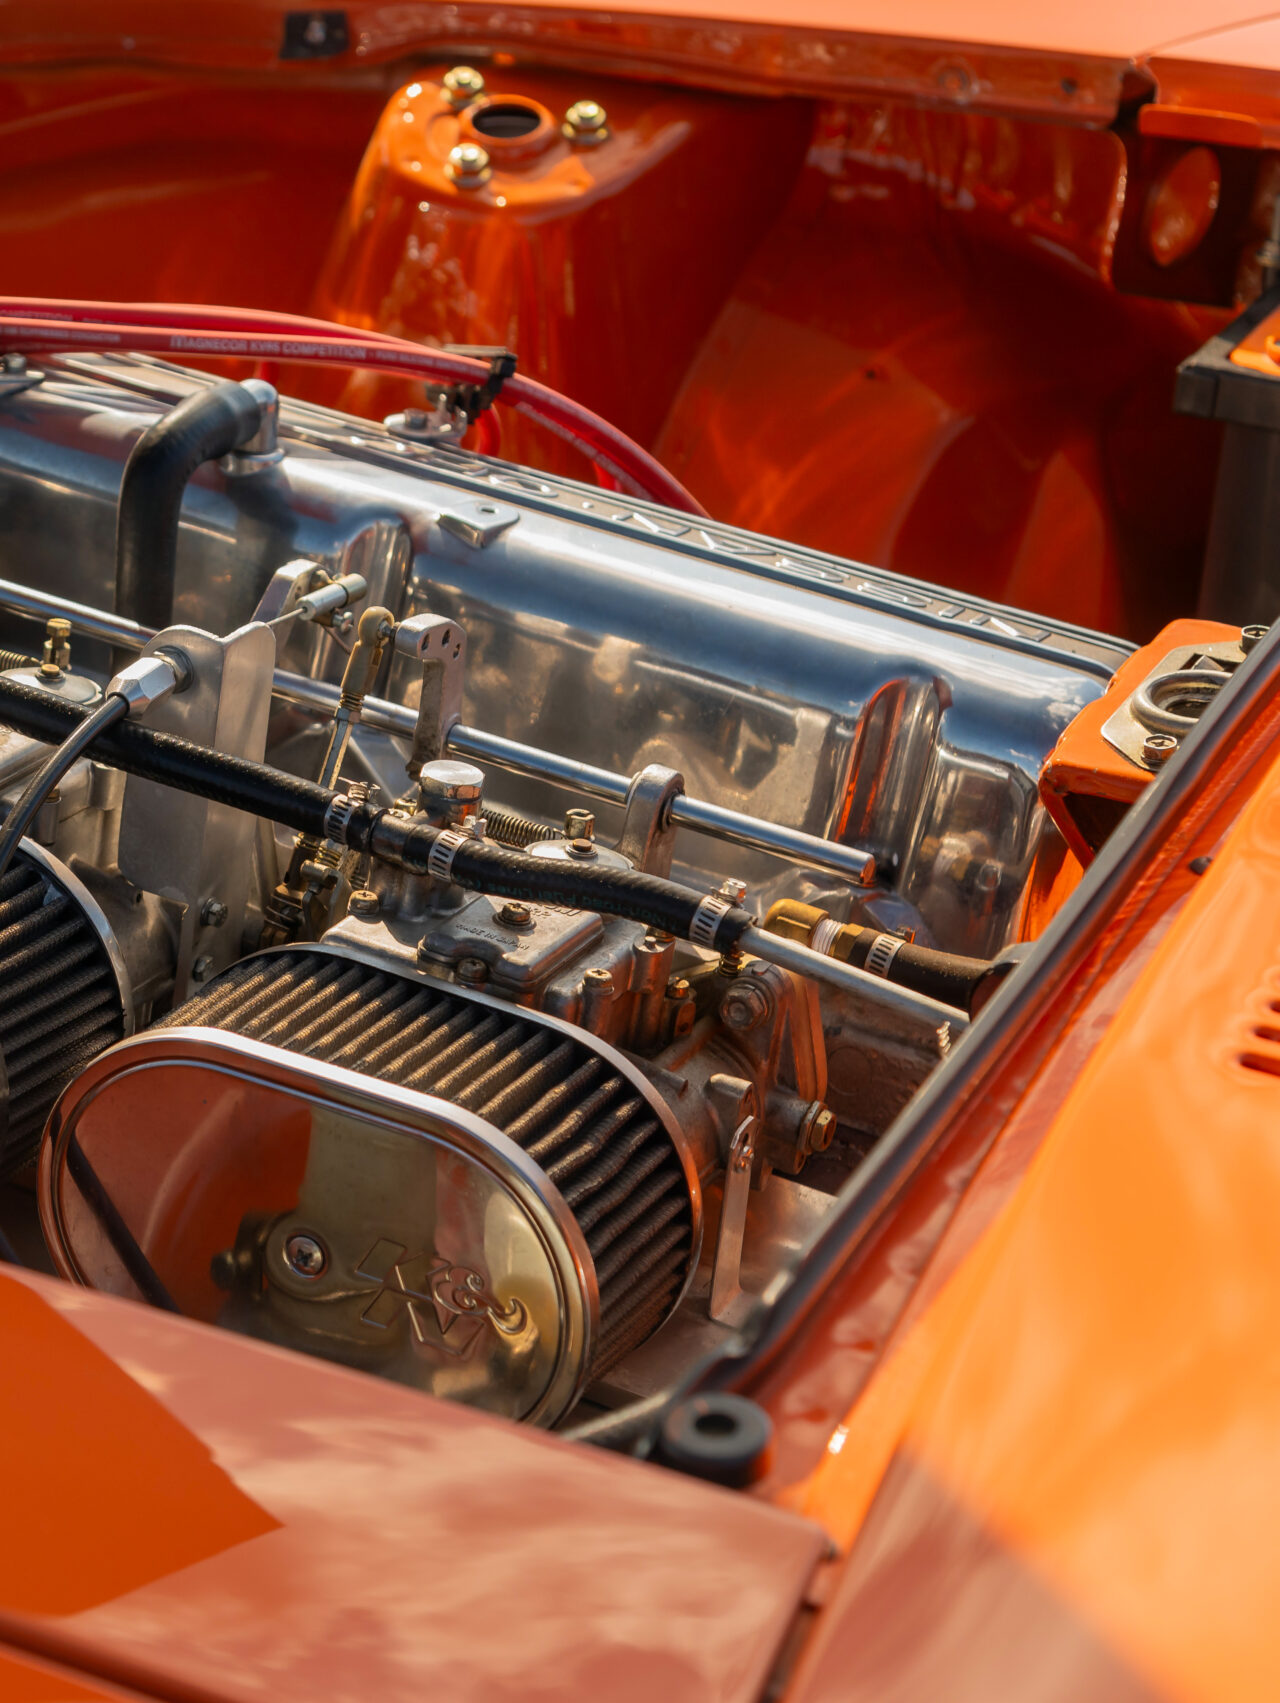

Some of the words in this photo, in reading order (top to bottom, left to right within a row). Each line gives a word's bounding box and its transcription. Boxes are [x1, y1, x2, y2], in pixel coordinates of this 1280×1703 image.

[170, 335, 248, 352] MAGNECOR
[282, 342, 367, 360] COMPETITION
[610, 512, 1051, 642] NISSAN
[537, 889, 577, 906] Fuel
[355, 1238, 528, 1355] K&N
